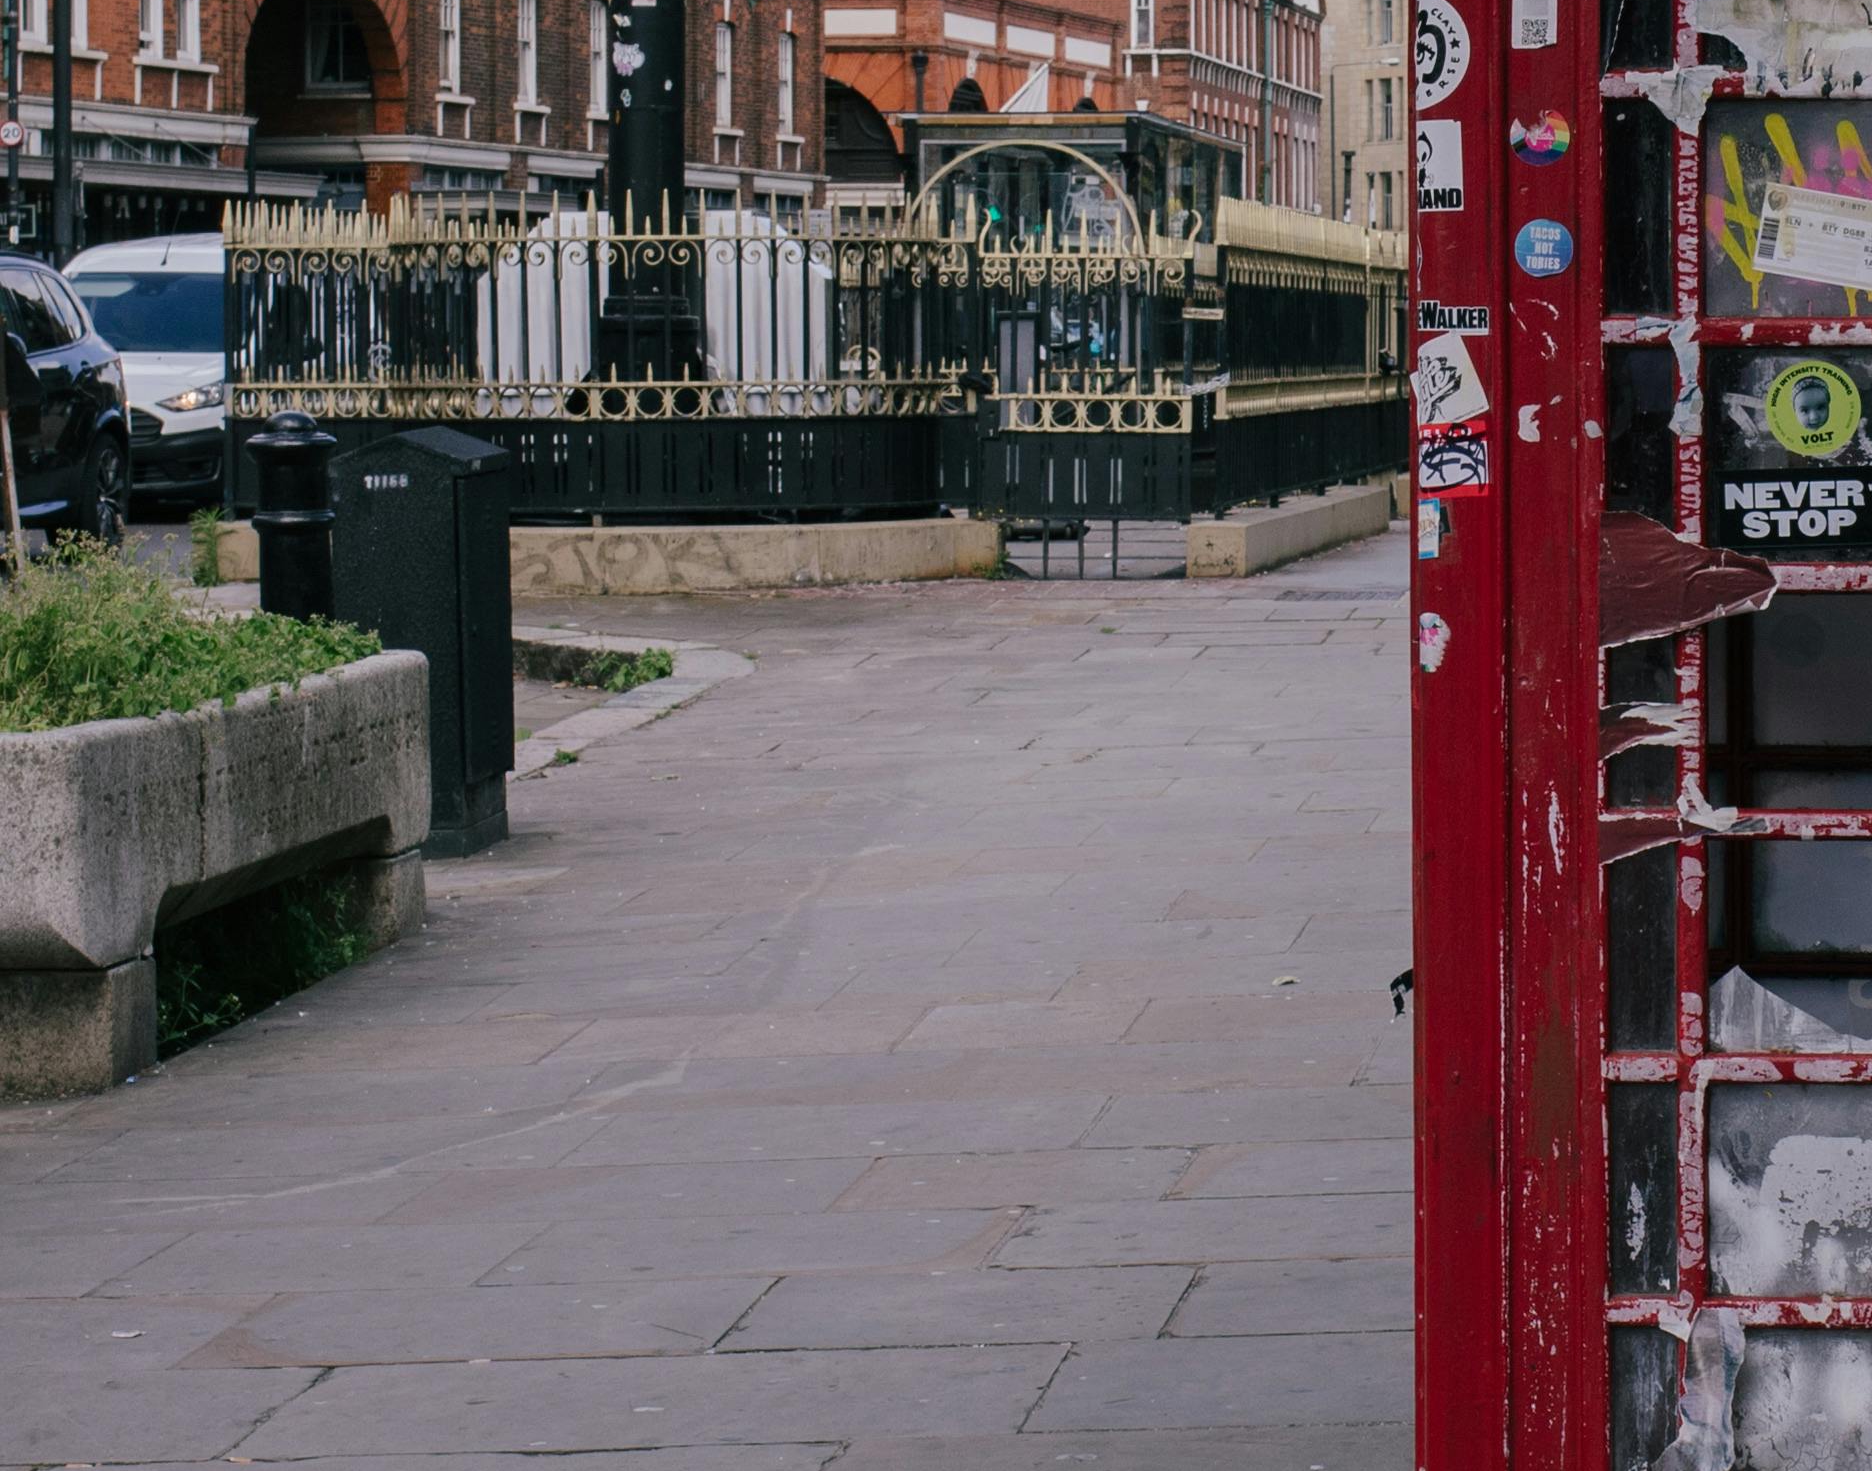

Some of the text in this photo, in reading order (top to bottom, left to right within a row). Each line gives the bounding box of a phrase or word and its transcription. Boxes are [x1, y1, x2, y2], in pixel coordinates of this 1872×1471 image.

[1530, 227, 1561, 241] TACOS
[1534, 241, 1554, 255] NOT
[1526, 255, 1561, 269] TORIES
[1801, 431, 1834, 445] VOLT
[1723, 479, 1865, 510] NEVER
[1742, 509, 1858, 540] STOP
